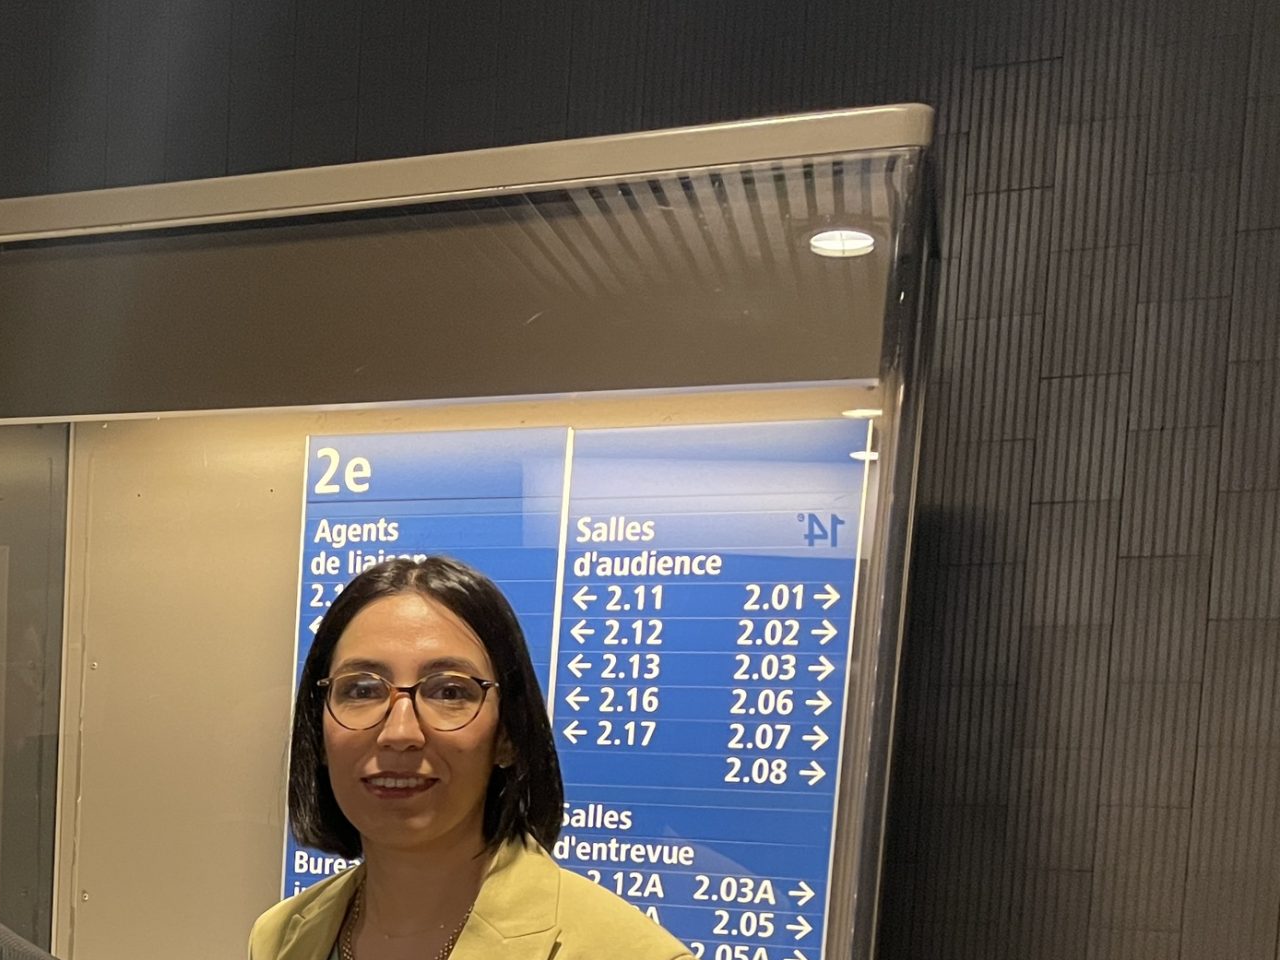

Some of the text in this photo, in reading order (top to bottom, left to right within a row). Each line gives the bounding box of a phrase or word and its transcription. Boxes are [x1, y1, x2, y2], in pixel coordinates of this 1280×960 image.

[312, 445, 375, 496] 2e
[314, 518, 399, 549] Agents
[576, 516, 656, 543] Salles
[310, 549, 428, 576] de liai
[573, 550, 723, 577] d'audience
[605, 585, 665, 612] 2.11
[742, 585, 806, 611] 2.01
[602, 620, 665, 646] 2.12
[736, 620, 802, 647] 2.02
[600, 654, 662, 680] 2.13
[732, 654, 798, 681] 2.03
[598, 687, 661, 713] 2.16
[729, 689, 795, 716] 2.06
[596, 721, 658, 747] 2.17
[727, 724, 793, 751] 2.07
[723, 758, 789, 786] 2.08
[553, 835, 695, 867] d'entrevue
[692, 875, 778, 906] 2.03A
[712, 910, 776, 939] 2.05
